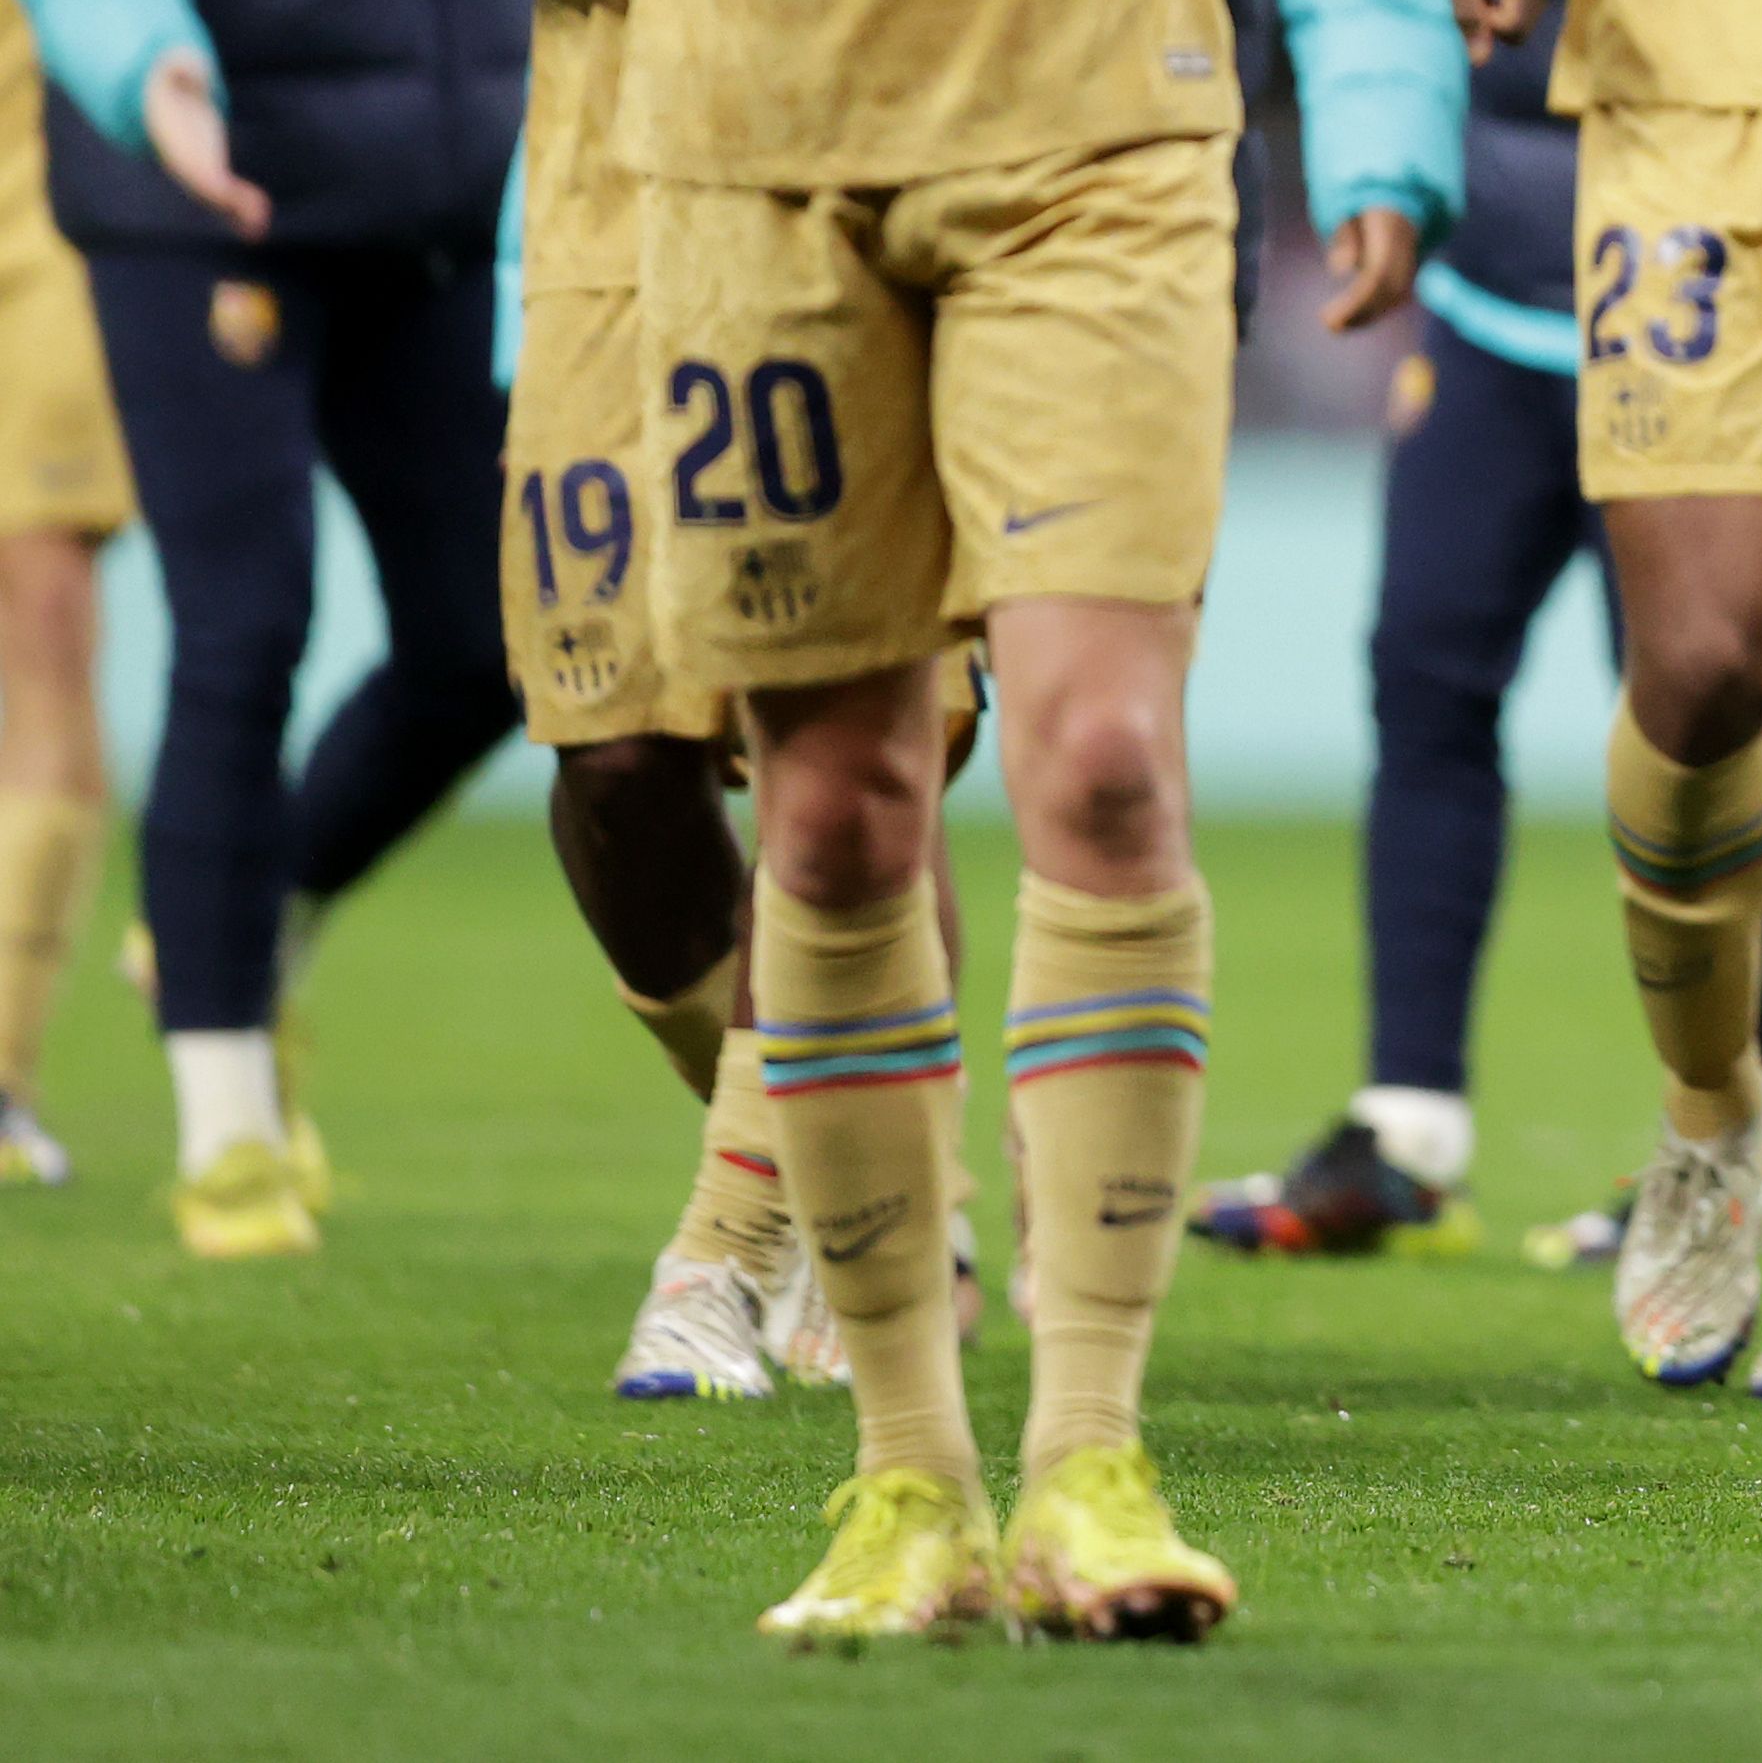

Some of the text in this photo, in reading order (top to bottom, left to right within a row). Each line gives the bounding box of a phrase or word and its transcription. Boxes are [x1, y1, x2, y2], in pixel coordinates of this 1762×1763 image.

[1589, 223, 1727, 364] 23
[670, 357, 843, 526] 20
[521, 457, 633, 609] 19
